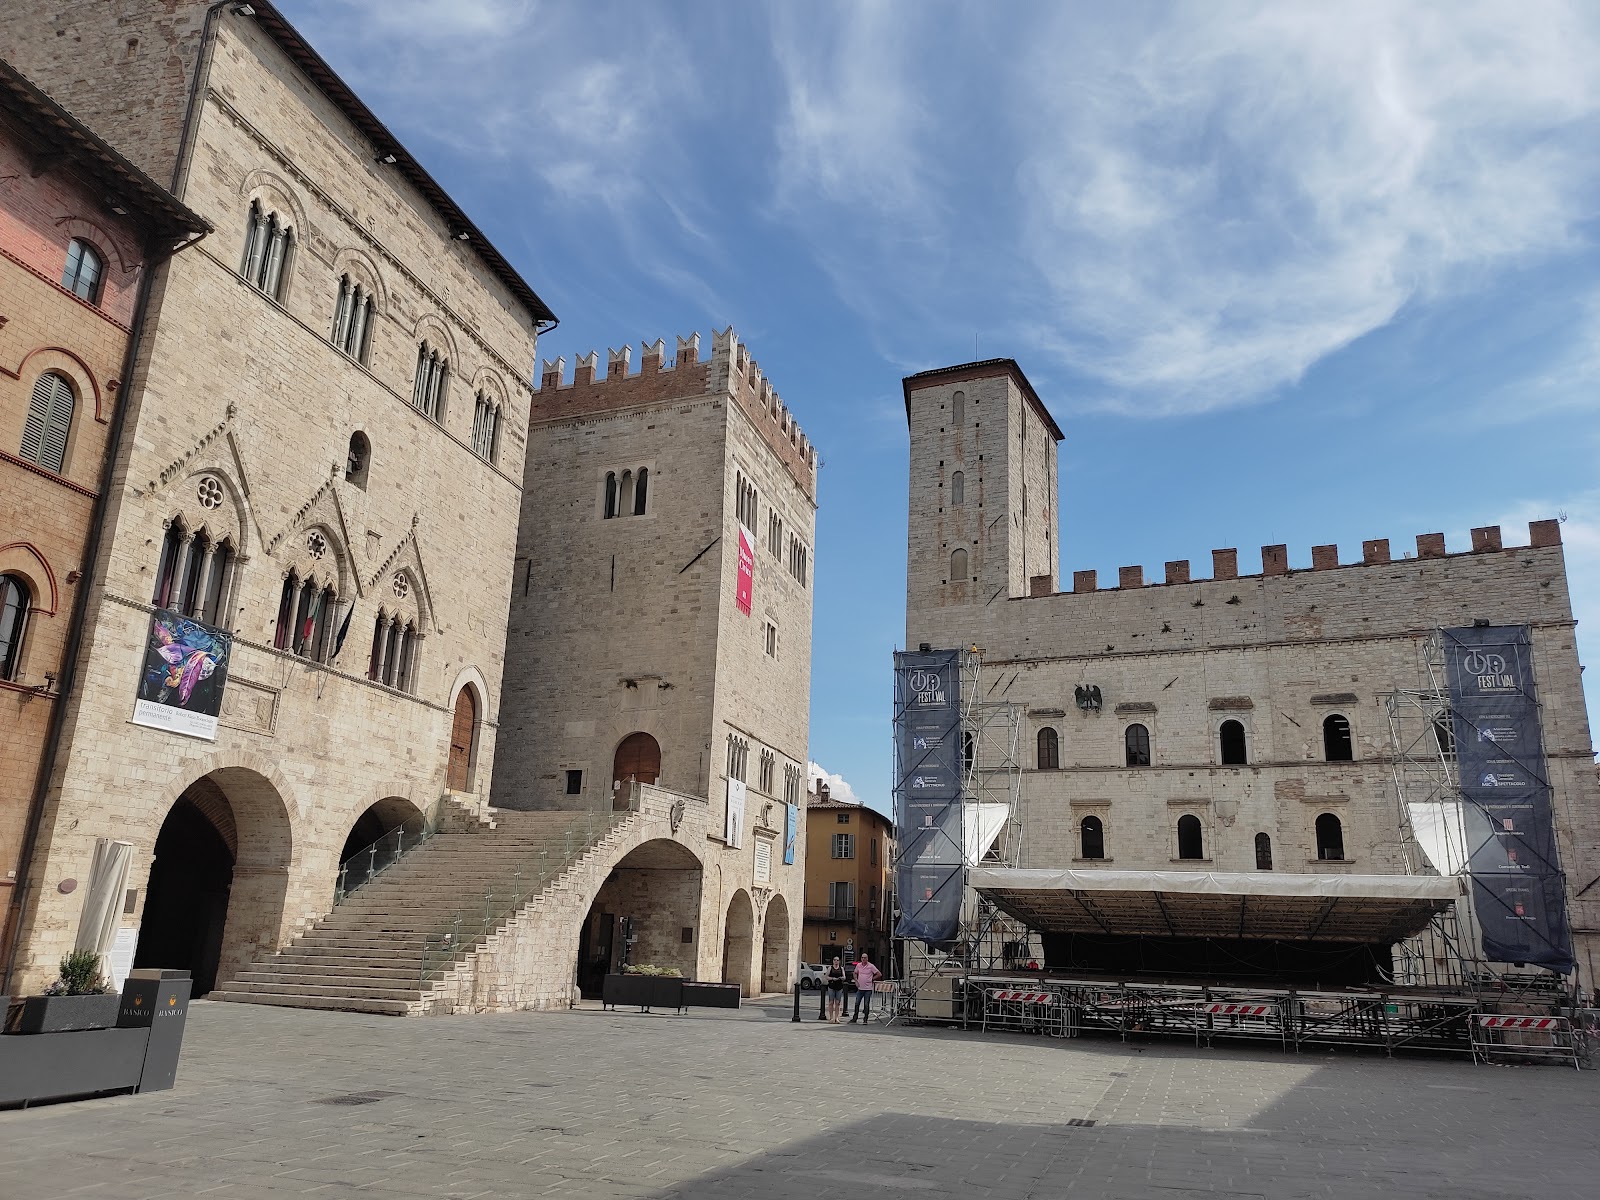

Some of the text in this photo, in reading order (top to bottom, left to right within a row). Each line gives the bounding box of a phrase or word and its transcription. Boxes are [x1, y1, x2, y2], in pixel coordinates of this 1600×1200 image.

[140, 702, 173, 715] transitorio
[123, 1008, 150, 1017] BASICO
[158, 1008, 183, 1017] BASICO
